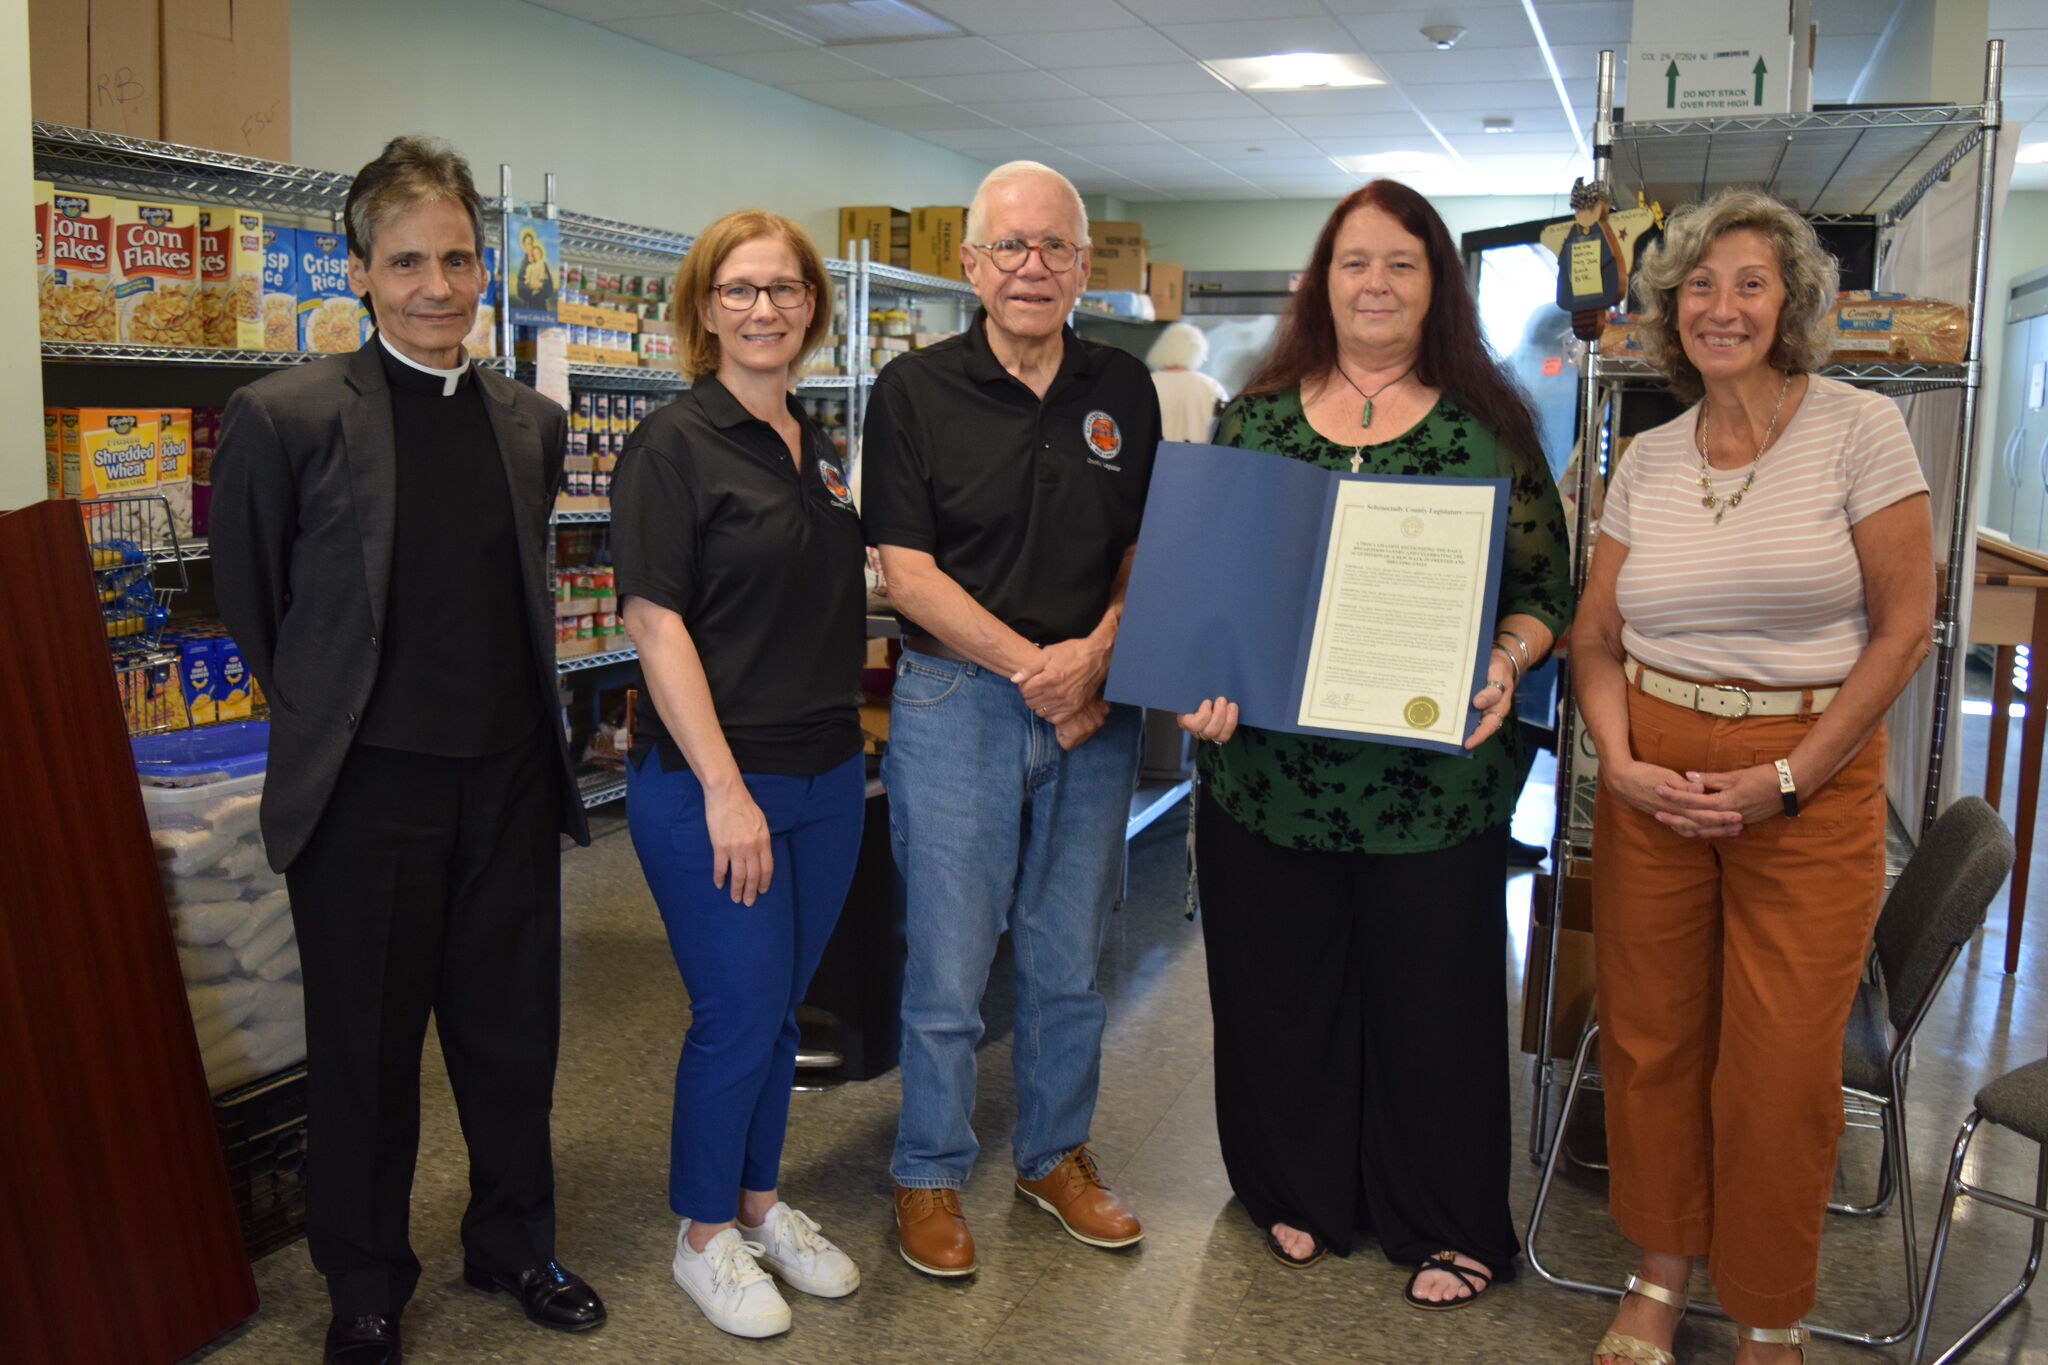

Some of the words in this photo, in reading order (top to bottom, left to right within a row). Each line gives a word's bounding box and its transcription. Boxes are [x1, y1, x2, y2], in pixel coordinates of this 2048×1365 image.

[1680, 101, 1704, 109] OVER
[1706, 100, 1726, 108] FIVE
[1727, 99, 1749, 108] HIGH
[1683, 90, 1696, 99] DO
[1697, 90, 1716, 98] NOT
[1718, 88, 1747, 97] STACK
[127, 225, 183, 249] Corn
[55, 237, 106, 262] akes
[123, 246, 191, 270] Flakes
[303, 252, 349, 279] Crisp
[311, 274, 346, 292] Rice
[95, 442, 155, 466] Shredded
[105, 461, 146, 480] Wheat
